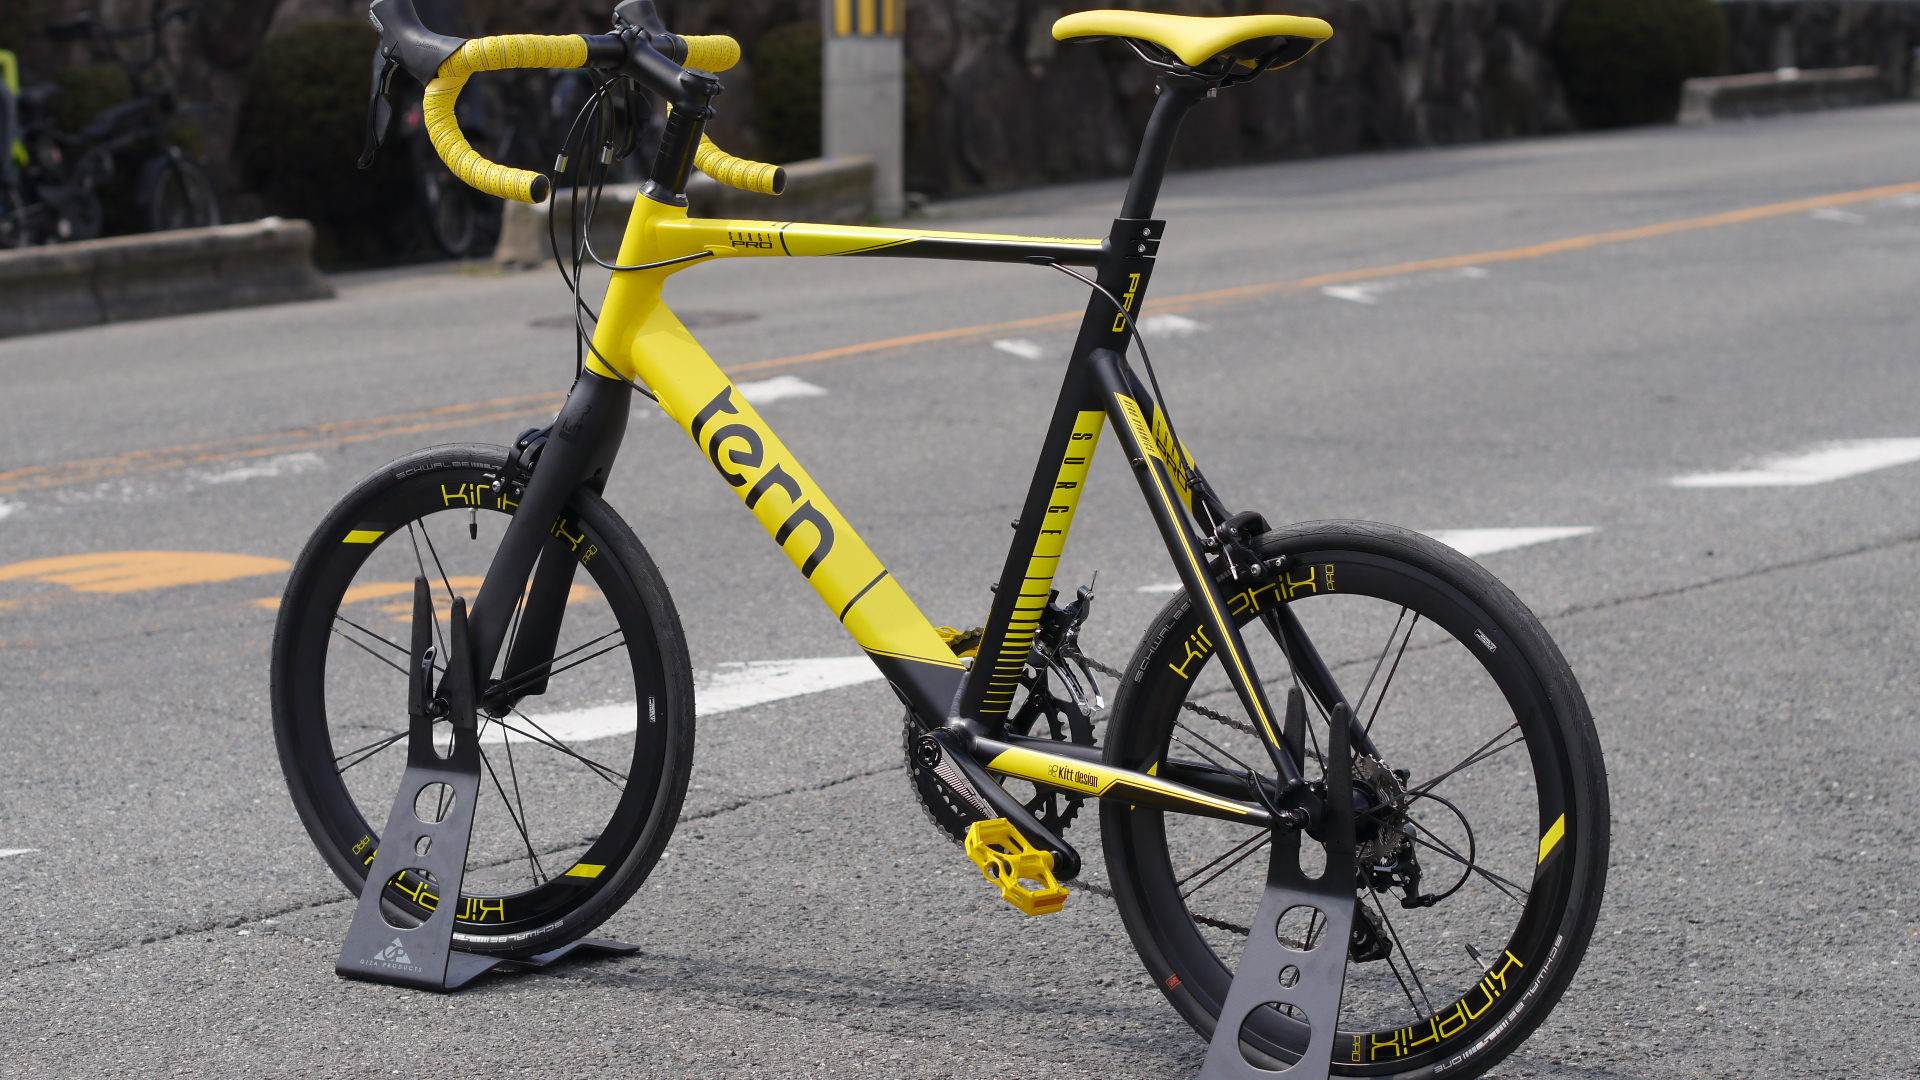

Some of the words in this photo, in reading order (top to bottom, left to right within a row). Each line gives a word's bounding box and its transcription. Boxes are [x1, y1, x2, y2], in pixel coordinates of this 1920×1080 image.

[728, 231, 771, 242] SURGE
[732, 241, 773, 249] PRO
[1112, 272, 1141, 333] PRO
[395, 461, 471, 480] SCHWALBE
[1156, 437, 1189, 493] PRO
[691, 384, 835, 580] tern
[1040, 432, 1093, 536] SURGE
[581, 543, 598, 565] PRO
[1325, 564, 1336, 591] PRO
[1134, 601, 1192, 683] SCHWALBE
[1058, 765, 1074, 782] Kitt
[1075, 771, 1099, 788] design
[351, 835, 371, 856] PRO
[490, 920, 564, 943] SCHWALBE
[359, 958, 379, 967] GIZA
[382, 961, 423, 973] PRODUCTS
[1508, 934, 1564, 1022] SCHWALBE
[1351, 1034, 1361, 1062] PRO
[1434, 1056, 1463, 1074] ONE
